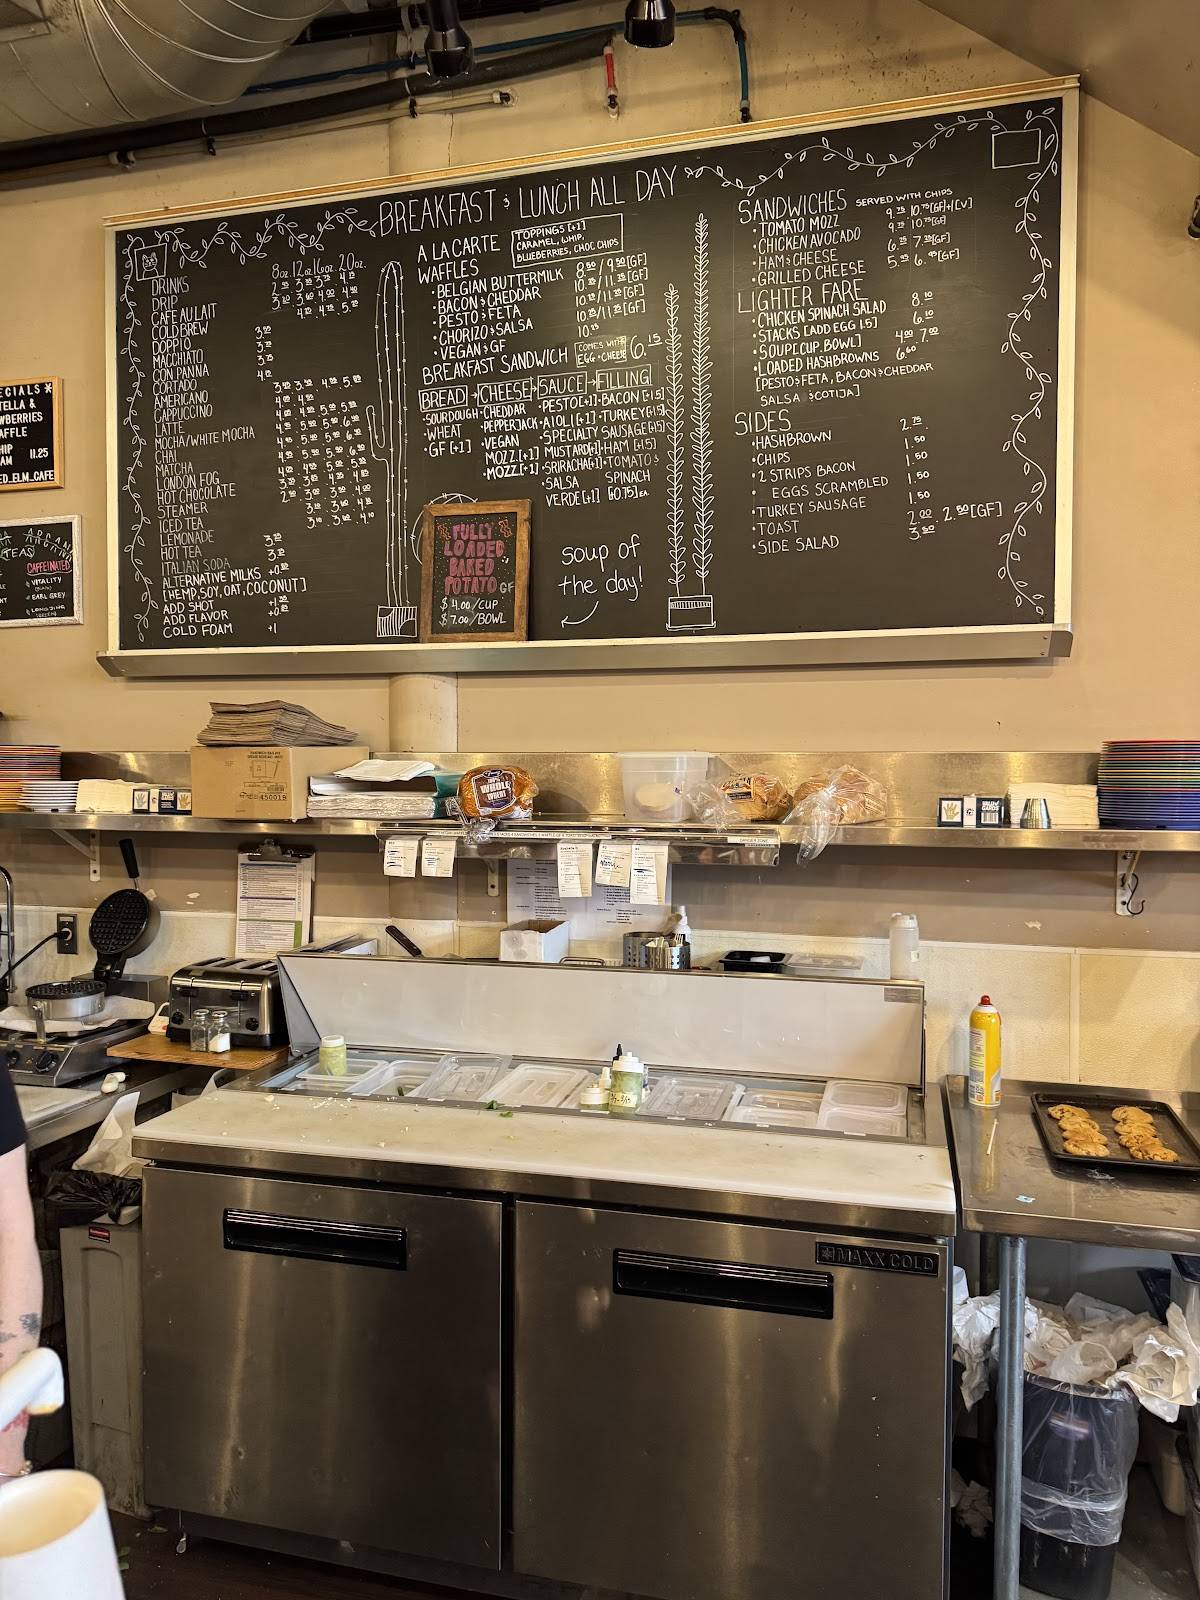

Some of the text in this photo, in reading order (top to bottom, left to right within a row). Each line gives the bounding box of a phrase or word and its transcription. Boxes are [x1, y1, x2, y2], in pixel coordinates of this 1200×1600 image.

[379, 165, 677, 237] BREAKFAST LUNCH ALL DAY
[738, 188, 952, 224] SANDWICHES SERVED WITH CHIPS
[516, 224, 564, 241] TOPPINGS
[759, 214, 840, 237] TOMATO MOZZ
[417, 235, 500, 263] A LA CARTE
[516, 234, 584, 251] CARAMEL, WHIP,
[758, 227, 861, 254] CHICKEN AVOCADO
[516, 238, 619, 263] BLUEBERRIES, CHOC CHIPS
[758, 249, 838, 270] HAM CHEESE
[418, 259, 479, 284] WAFFLES
[757, 261, 866, 286] GRILLED CHEESE
[152, 276, 189, 296] DRINKS
[437, 267, 563, 298] BELGIAN BUTTERMILK
[152, 296, 178, 311] DRIP
[438, 287, 541, 315] BACON CHEDDAR
[738, 279, 868, 312] LIGHTER FARE
[151, 310, 177, 325] CAFE
[439, 304, 522, 329] PESTO FETA
[757, 310, 805, 327] CHICKEN
[808, 303, 849, 321] SPINACH
[853, 300, 886, 315] SALAD
[152, 321, 208, 340] COLD BREW
[439, 318, 533, 346] CHORIZO SALSA
[758, 327, 800, 343] STACKS
[803, 322, 831, 337] [ADD
[833, 321, 855, 333] EGG
[152, 338, 191, 355] DOPPIO
[440, 340, 506, 360] VEGAN GF
[579, 342, 603, 351] COMES
[153, 349, 204, 369] MACCHIATO
[422, 347, 568, 385] BREAKFAST SANDWICH
[578, 352, 595, 365] EGG
[758, 351, 880, 375] LOADED HASHBROWNS
[152, 364, 209, 383] CON PANNA
[598, 369, 650, 389] FILLING
[836, 369, 876, 383] BACON
[884, 363, 933, 377] CHEDDAR
[153, 379, 197, 395] CORTADO
[480, 382, 529, 402] CHEESE
[539, 375, 584, 396] SAUCE
[29, 398, 36, 409] &
[154, 391, 209, 409] AMERICANO
[422, 389, 467, 409] BREAD
[602, 391, 640, 406] BACON
[760, 393, 800, 406] SALSA
[154, 404, 212, 423] CAPPUCCINO
[425, 408, 478, 425] SOURDOUGH
[483, 404, 526, 419] CHEDDAR
[602, 408, 646, 422] TURKEY
[155, 421, 184, 438] LATTE
[483, 417, 538, 433] PEPPERJACK
[543, 414, 574, 429] AIOLI
[735, 409, 791, 435] SIDES
[155, 426, 255, 451] MOCHA/WHITE MOCHA
[427, 424, 462, 441] WHEAT
[543, 426, 598, 445] SPECIALTY
[602, 423, 647, 440] SAUSAGE
[756, 430, 832, 450] HASHBROWN
[429, 443, 446, 457] GF
[484, 434, 519, 450] VEGAN
[604, 440, 629, 455] HAM
[30, 448, 49, 459] 11.25
[154, 450, 177, 464] CHAI
[607, 454, 651, 468] TOMATO
[757, 452, 791, 466] CHIPS
[155, 462, 194, 477] MATCHA
[605, 470, 651, 484] SPINACH
[757, 471, 766, 482] 2
[770, 466, 811, 482] STRIPS
[817, 461, 856, 477] BACON
[156, 471, 220, 491] LONDON FOG
[545, 475, 580, 490] SALSA
[772, 485, 809, 499] EGGS
[815, 476, 889, 496] SCRAMBLED
[157, 483, 236, 505] HOT CHOCOLATE
[546, 491, 582, 507] VERDE
[157, 503, 208, 519] STEAMER
[757, 502, 803, 519] TURKEY
[808, 497, 867, 513] SAUSAGE
[159, 516, 204, 533] ICED TEA
[452, 523, 493, 540] FULLY
[757, 520, 800, 536] TOAST
[160, 530, 215, 547] LEMONADE
[757, 535, 840, 555] SIDE SALAD
[160, 545, 202, 560] HOT TEA
[443, 540, 505, 557] LOADED
[561, 533, 640, 572] soup of
[27, 560, 70, 573] CAFFEINATED
[162, 558, 231, 576] ITALIAN SODA
[449, 558, 495, 577] BAKED
[31, 577, 62, 586] VITALITY
[163, 567, 262, 589] ALTERNATIVE MILKS
[444, 576, 514, 596] POTATO GF
[558, 565, 644, 602] the day!
[163, 600, 214, 615] ADD SHOT
[163, 610, 229, 626] ADD FLAVOR
[163, 627, 197, 639] COLD
[202, 623, 233, 636] FOAM
[480, 781, 510, 794] WHOLE
[838, 1247, 933, 1270] MAXX COLD
